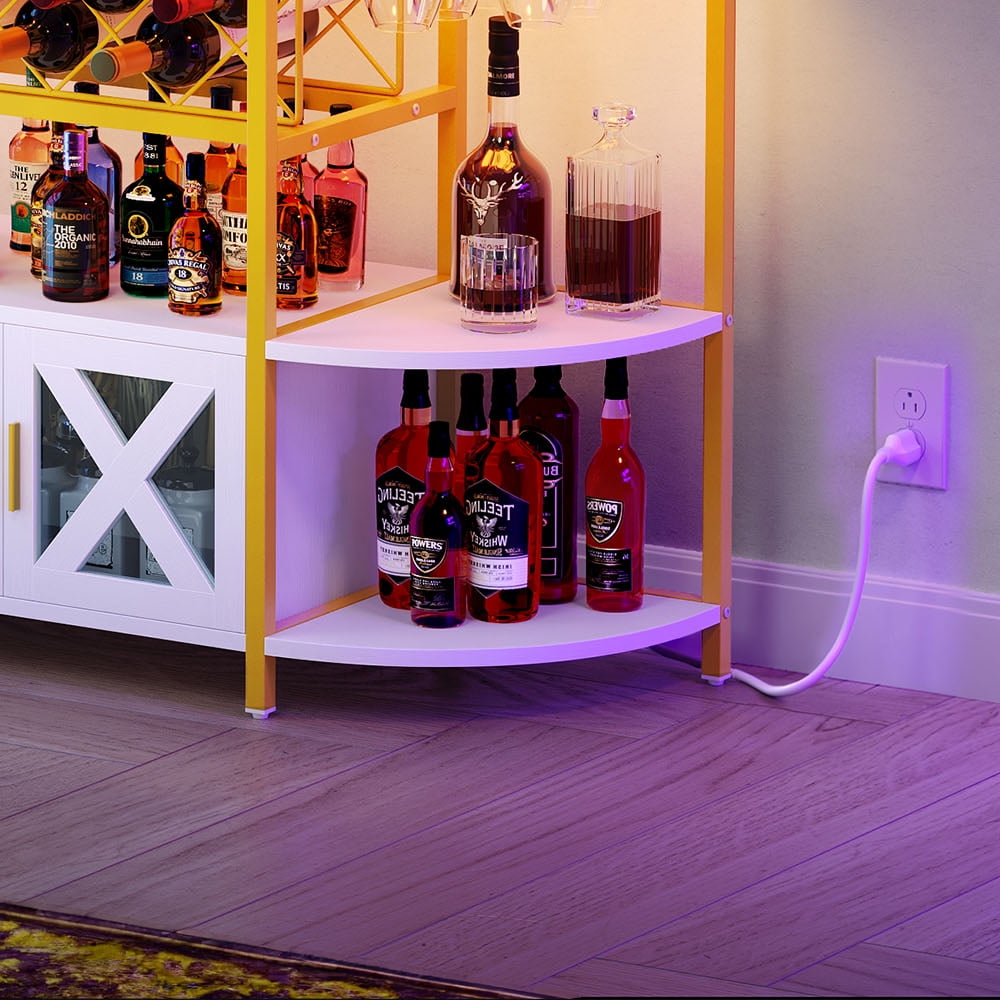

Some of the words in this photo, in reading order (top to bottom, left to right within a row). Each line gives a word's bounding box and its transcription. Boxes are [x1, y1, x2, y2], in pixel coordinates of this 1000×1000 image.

[14, 165, 29, 173] THE
[15, 181, 28, 192] 12
[53, 223, 76, 234] THE
[53, 232, 97, 243] ORGANIC
[53, 240, 78, 250] 2010
[184, 260, 208, 271] REGAL
[131, 272, 144, 281] 18
[178, 269, 187, 279] 18
[411, 539, 443, 550] POWERS
